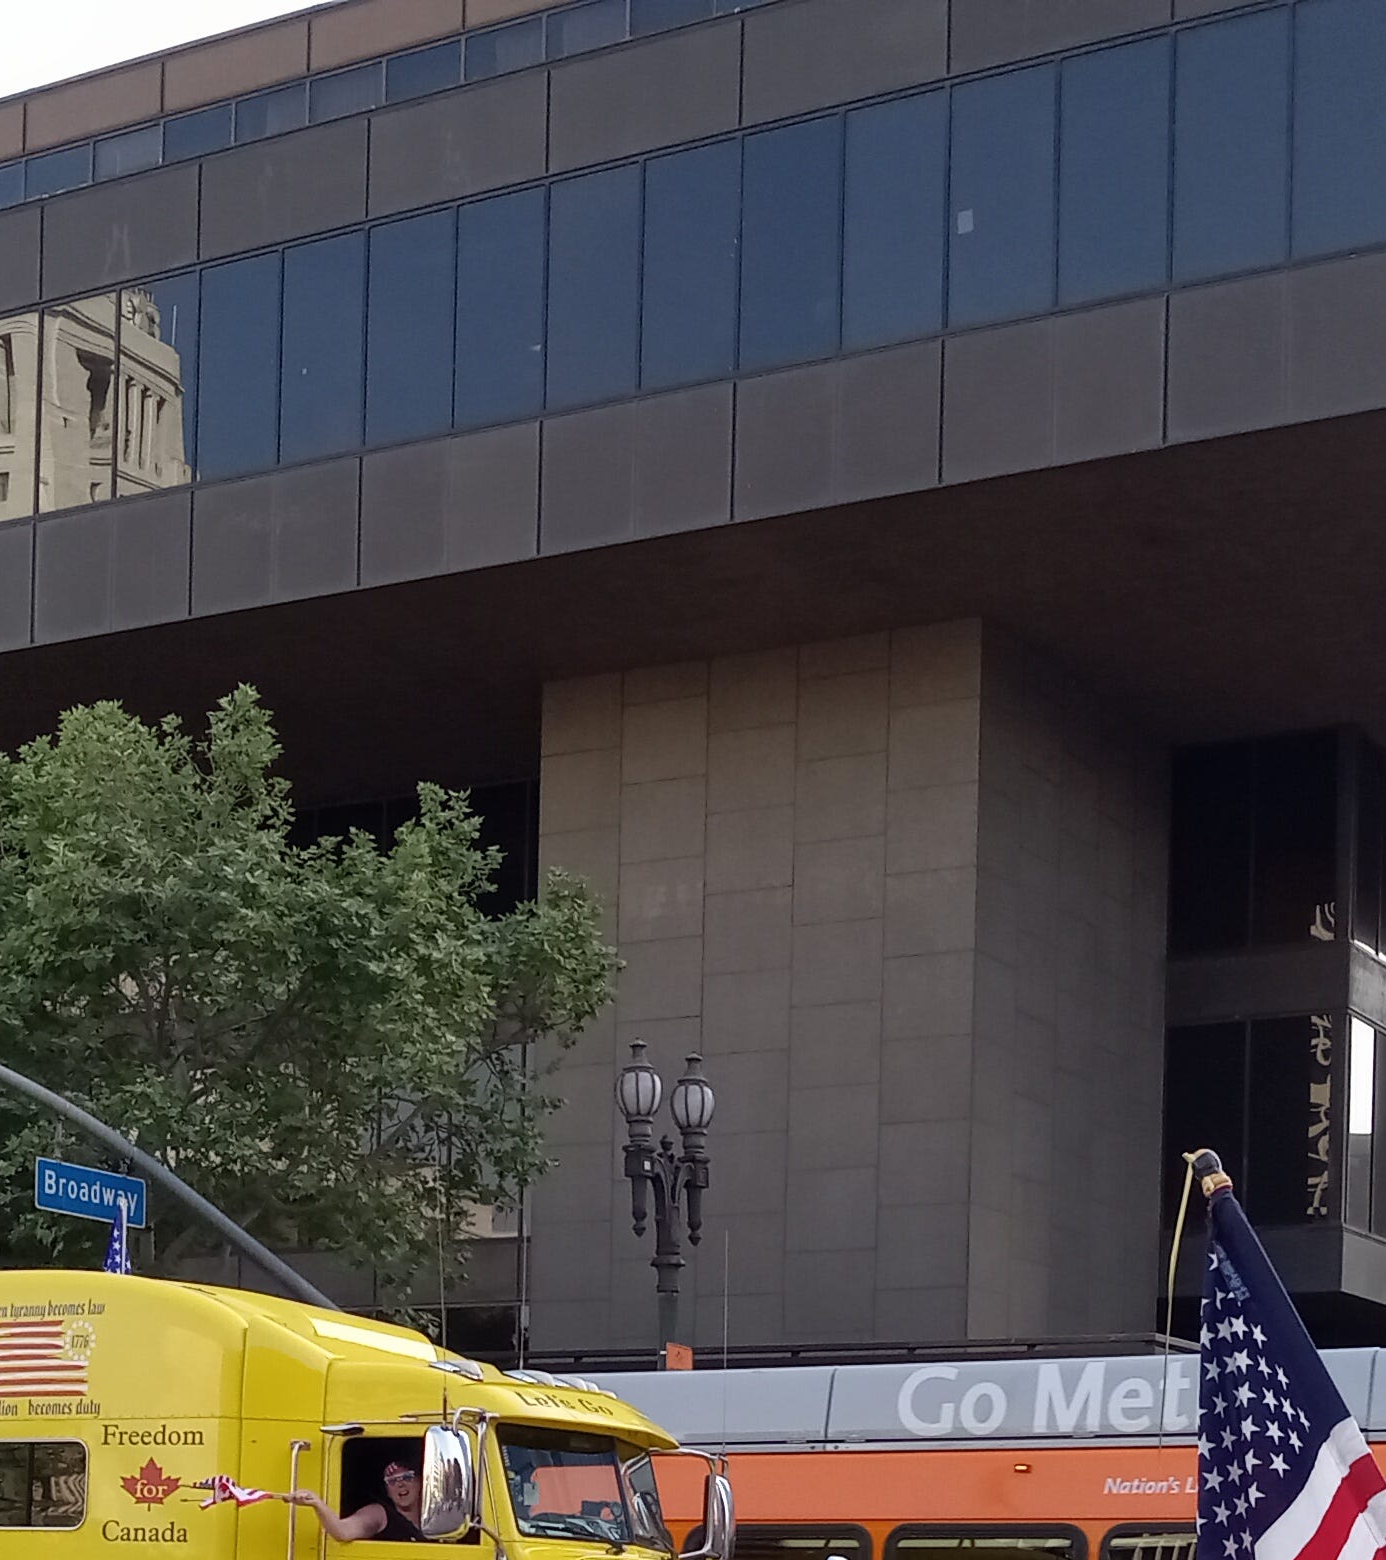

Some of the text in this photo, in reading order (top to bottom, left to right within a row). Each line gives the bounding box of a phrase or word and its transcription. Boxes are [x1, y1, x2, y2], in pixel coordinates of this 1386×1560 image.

[44, 1169, 138, 1217] Broadway
[10, 1302, 46, 1320] tyranny
[47, 1299, 85, 1316] becomes
[87, 1298, 106, 1315] law
[71, 1334, 89, 1349] 1776
[28, 1399, 72, 1416] becomes
[76, 1398, 101, 1417] duty
[578, 1397, 614, 1416] Go
[897, 1361, 1191, 1436] Go Met
[101, 1424, 205, 1446] Freedom
[135, 1480, 168, 1498] for
[1103, 1477, 1179, 1495] Nation's
[102, 1520, 189, 1543] Canada
